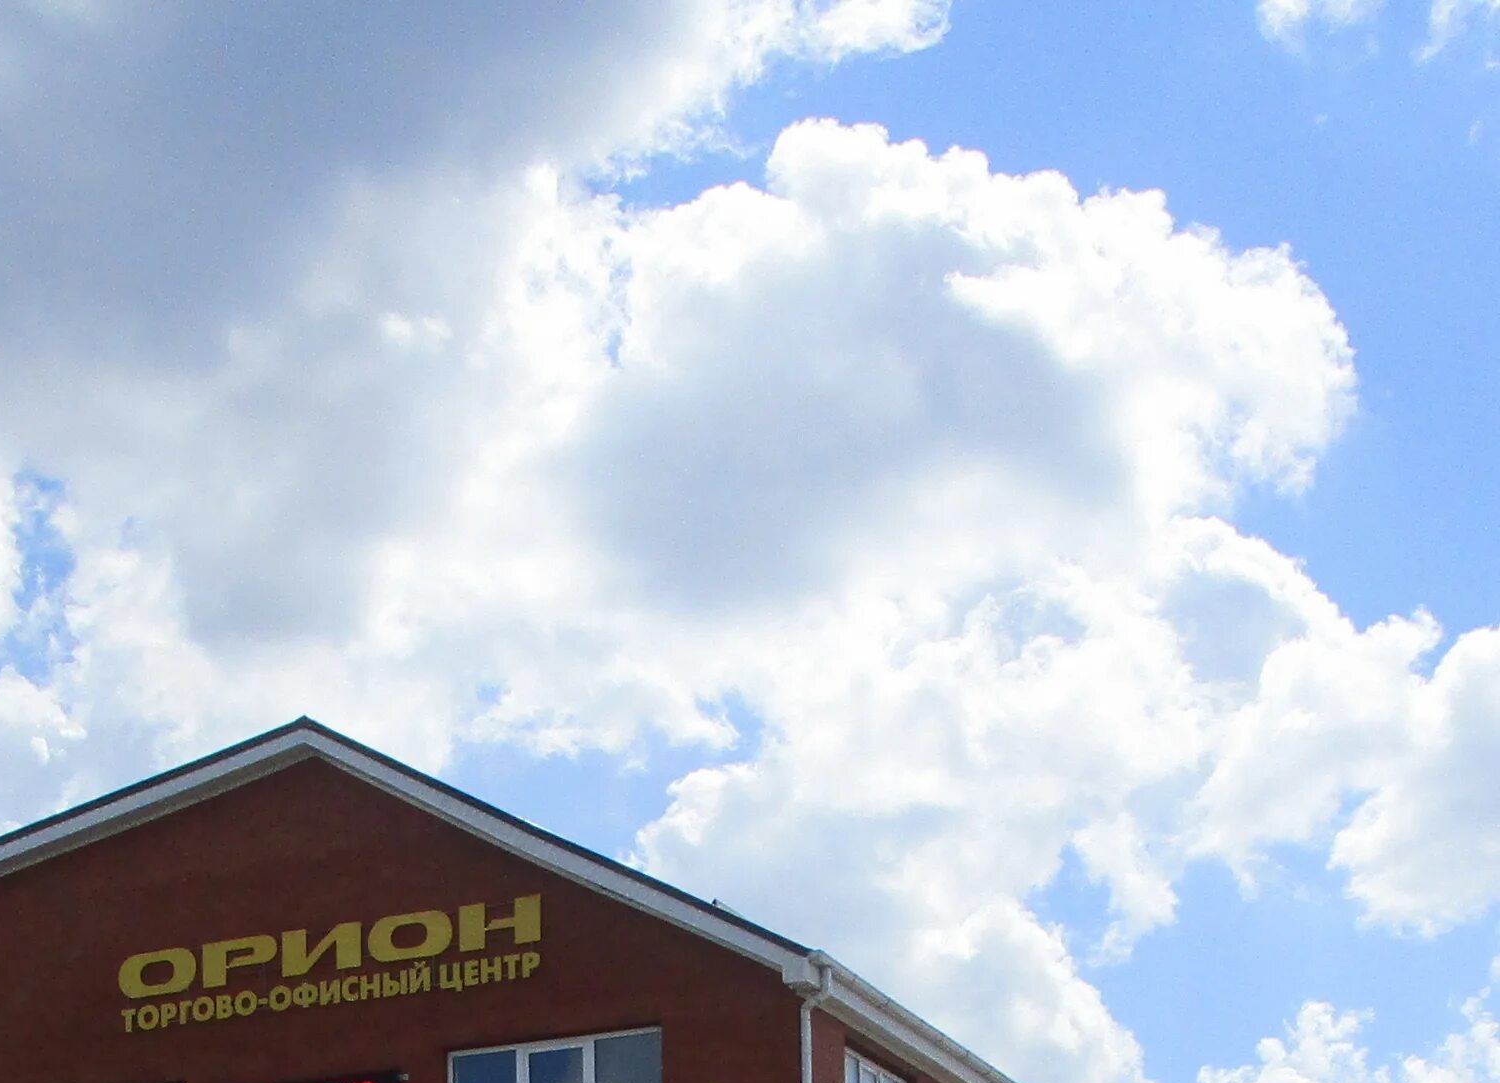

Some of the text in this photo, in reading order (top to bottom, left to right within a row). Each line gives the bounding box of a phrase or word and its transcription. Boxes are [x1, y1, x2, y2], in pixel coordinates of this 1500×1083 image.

[118, 893, 541, 998] ОРИОН
[121, 952, 541, 1032] ТОРГОВО-ОФИСНЫЙ ЦЕНТР
